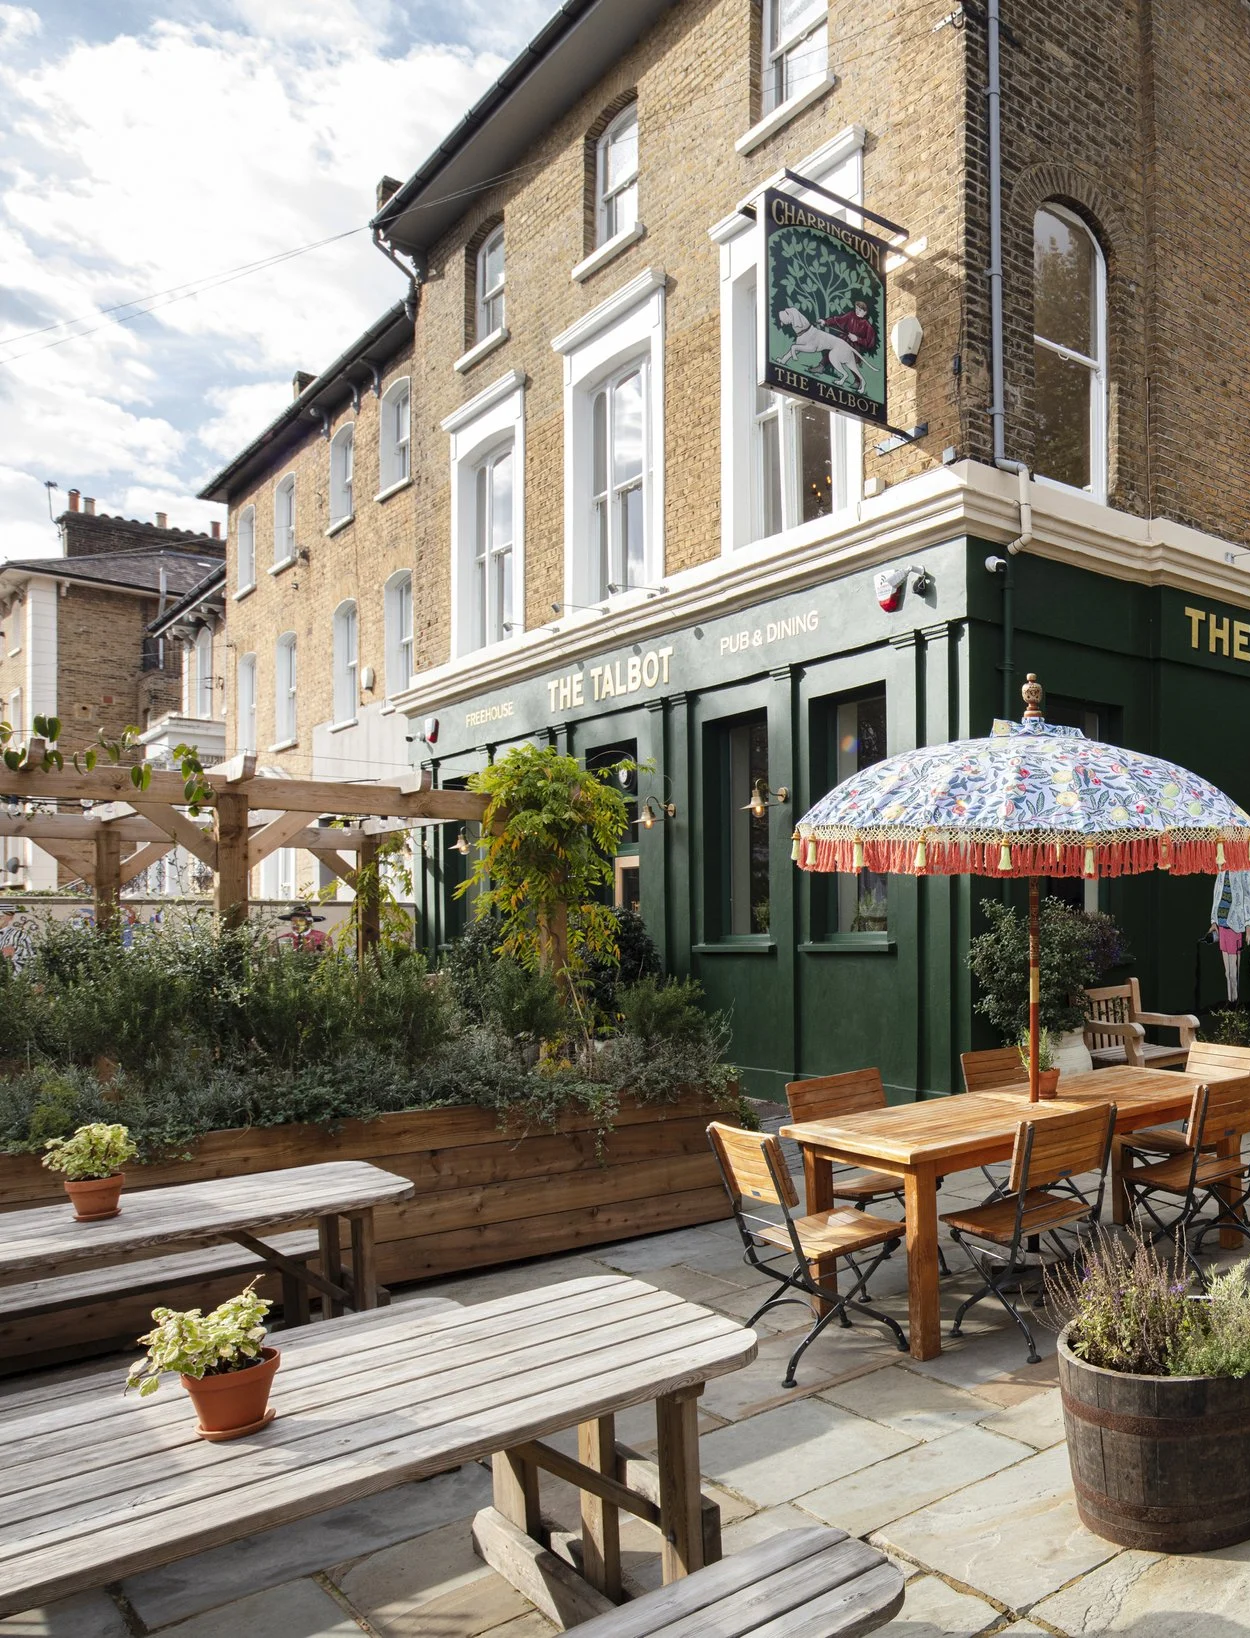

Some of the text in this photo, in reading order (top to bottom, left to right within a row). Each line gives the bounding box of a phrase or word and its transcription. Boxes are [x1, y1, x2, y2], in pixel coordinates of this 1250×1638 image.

[771, 198, 880, 273] CHARRINGTON
[775, 367, 879, 416] THE TALBOT
[720, 610, 819, 656] PUB & DINING
[547, 646, 675, 713] THE TALBOT
[465, 700, 514, 728] FREEHOUSE
